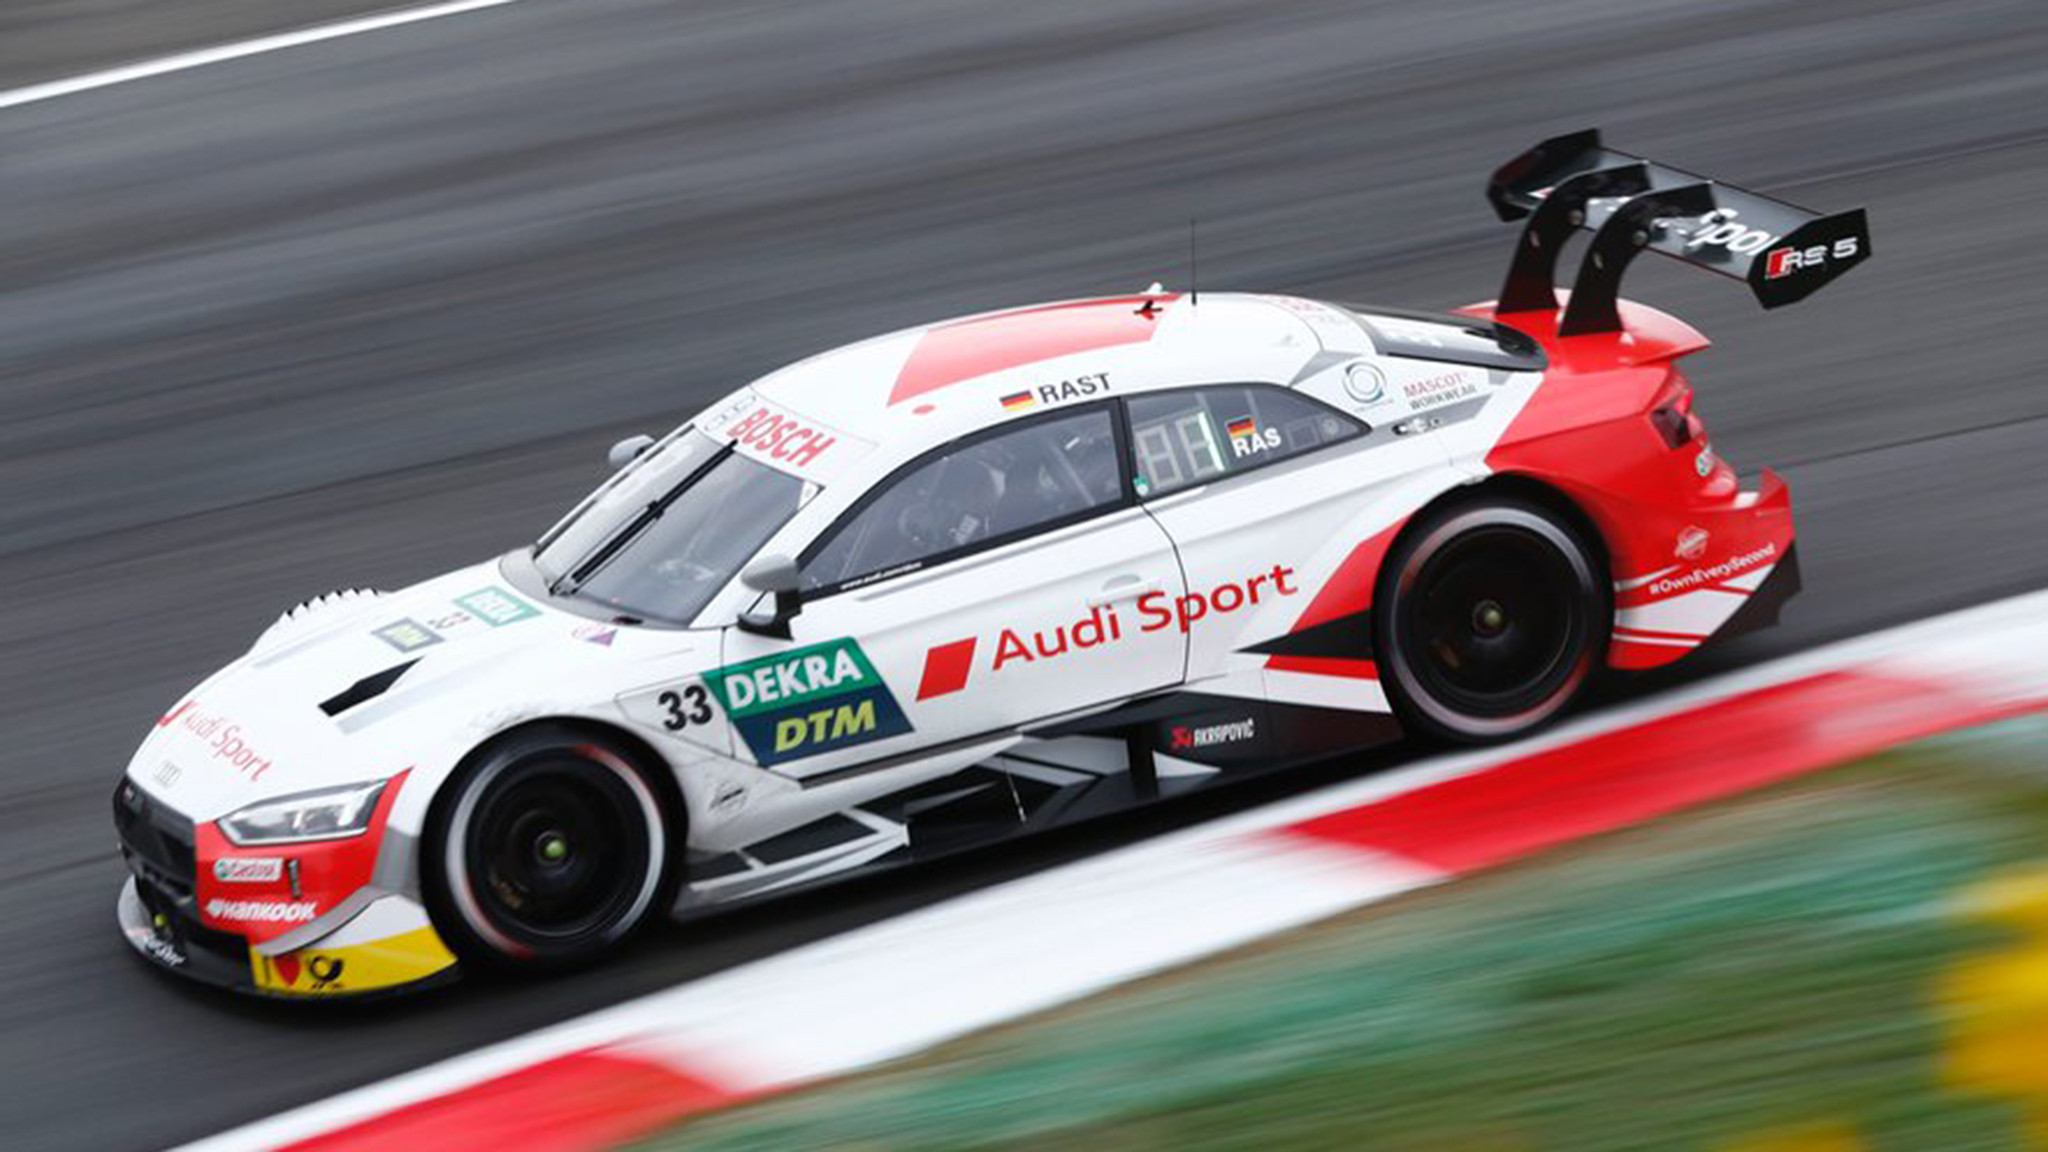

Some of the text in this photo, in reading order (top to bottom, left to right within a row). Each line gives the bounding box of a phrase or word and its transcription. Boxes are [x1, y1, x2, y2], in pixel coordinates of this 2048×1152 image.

[1833, 236, 1858, 259] 5
[1038, 372, 1113, 404] RAST
[1403, 372, 1462, 398] MASCOT
[1410, 384, 1478, 410] WORKWEAR
[726, 408, 836, 467] BOSCH
[1231, 428, 1282, 458] RAS
[992, 563, 1298, 671] Audi Sport
[724, 648, 863, 710] DEKRA
[658, 684, 713, 732] 33
[775, 699, 876, 754] DTM
[210, 724, 272, 782] Sport
